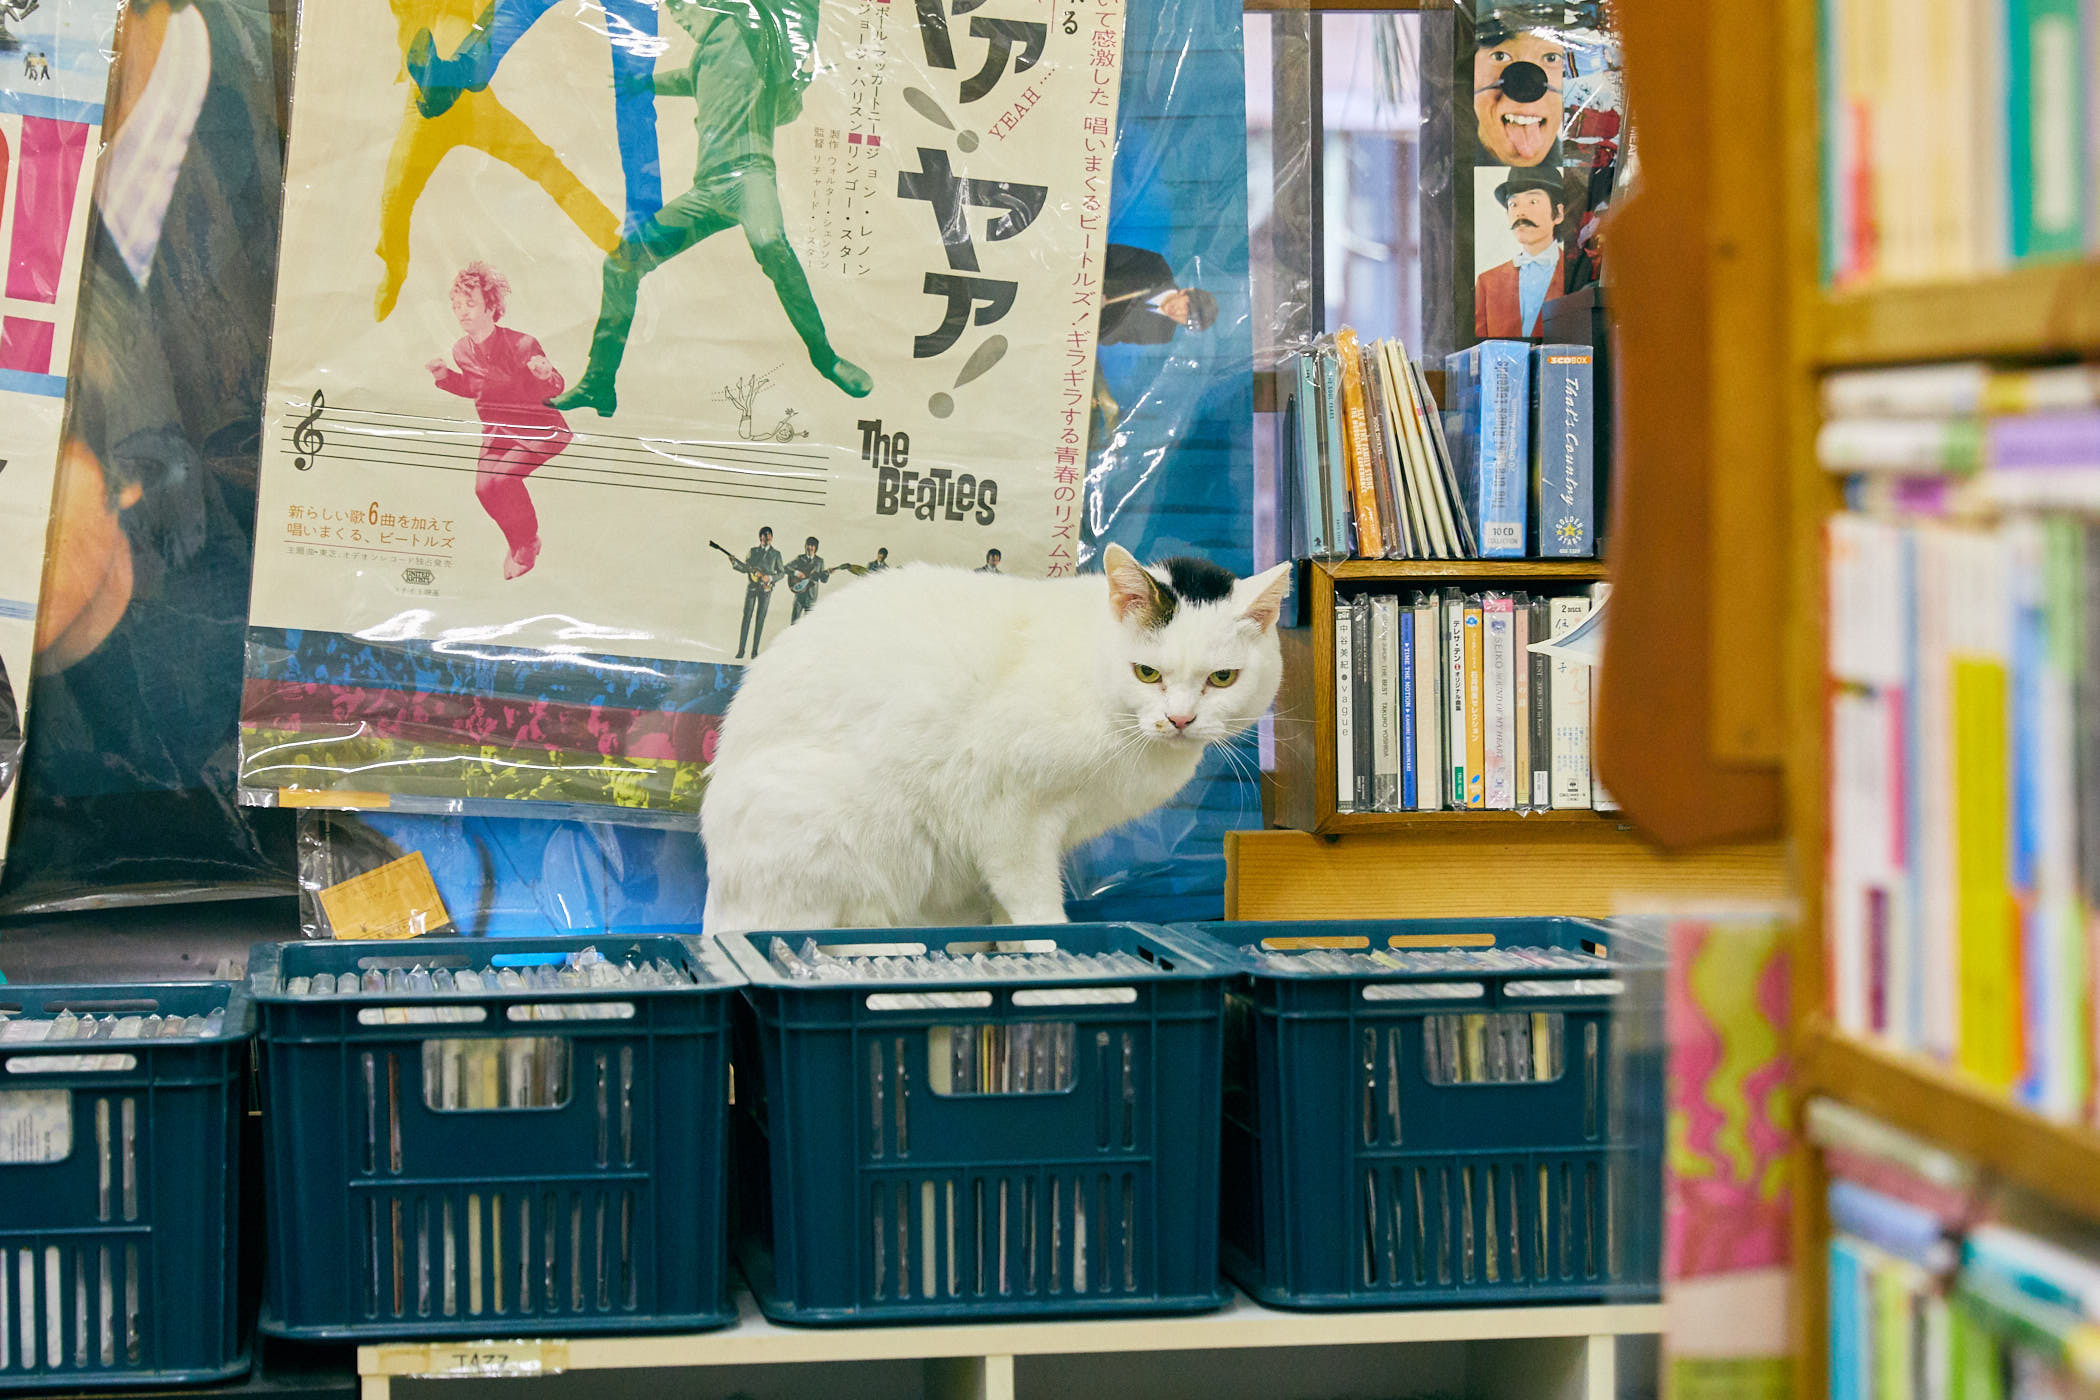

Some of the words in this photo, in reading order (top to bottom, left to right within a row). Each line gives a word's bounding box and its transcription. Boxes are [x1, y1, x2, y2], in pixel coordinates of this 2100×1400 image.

[840, 145, 859, 274] リンゴー・スター
[1565, 378, 1579, 427] That's
[857, 419, 910, 468] The
[1560, 433, 1579, 507] Country
[287, 501, 454, 532] 新らしい歌6曲を加えて
[1503, 527, 1513, 536] CD
[286, 523, 456, 548] 唱いまくる、ビートルズ
[406, 570, 431, 579] UNITED
[1561, 604, 1567, 613] 2
[1453, 620, 1461, 662] テレサ・テン
[1495, 638, 1504, 669] SEIKO
[1341, 685, 1349, 737] vague
